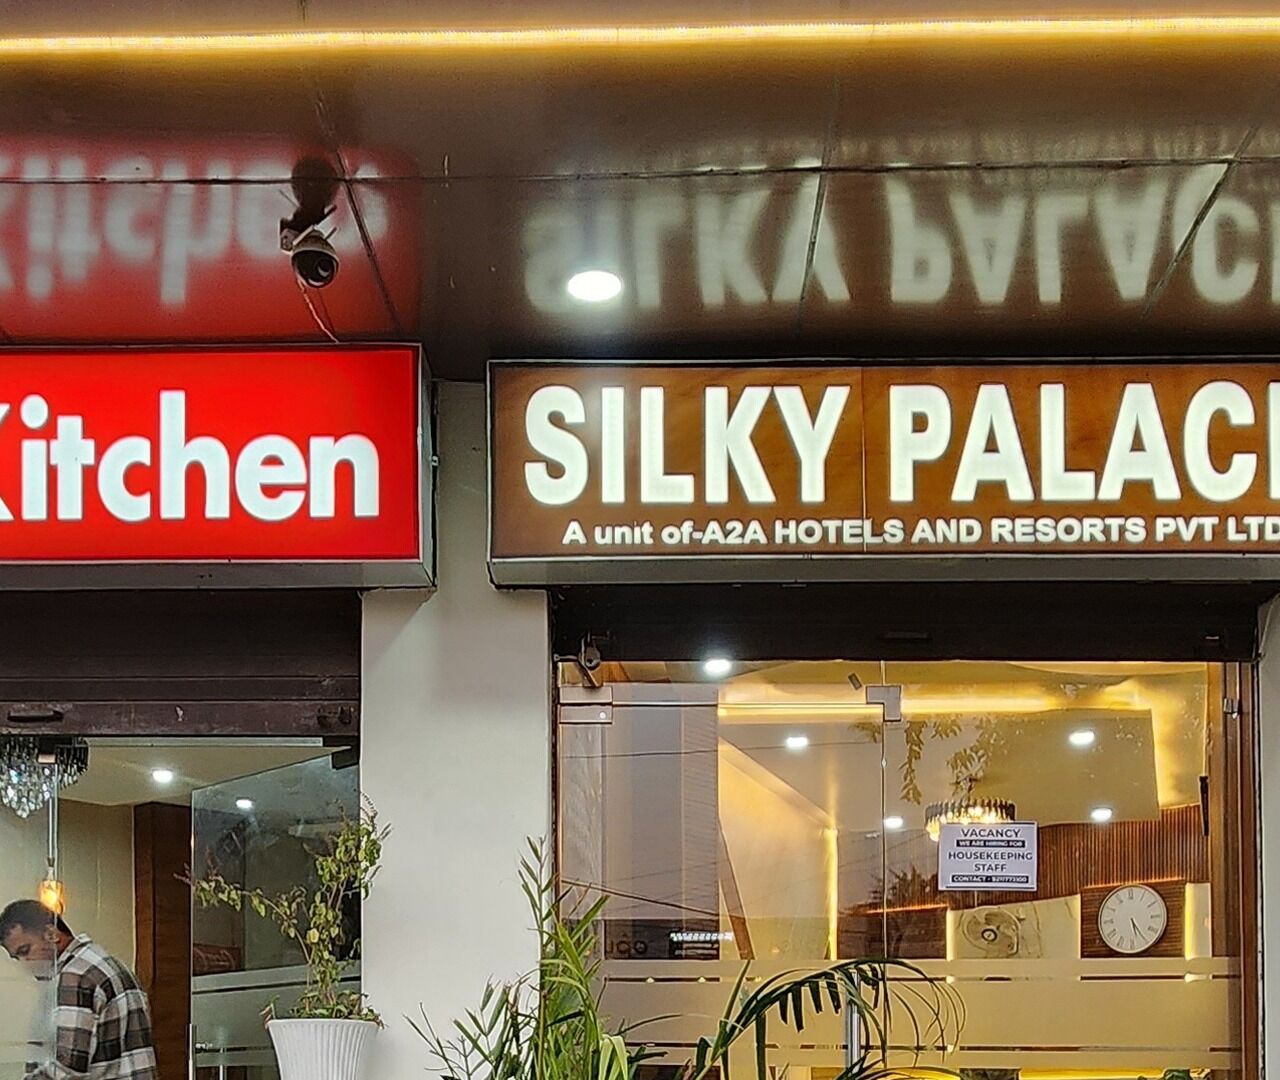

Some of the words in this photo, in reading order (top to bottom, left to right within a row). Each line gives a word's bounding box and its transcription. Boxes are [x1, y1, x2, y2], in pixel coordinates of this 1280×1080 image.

[523, 384, 851, 506] SILKY
[561, 520, 588, 546] A
[593, 520, 654, 547] unit
[660, 519, 768, 547] of-A2A
[774, 518, 905, 545] HOTELS
[910, 518, 983, 544] AND
[990, 516, 1147, 544] RESORTS
[1154, 516, 1220, 543] PVT
[960, 828, 1021, 838] VACANCY
[948, 851, 1033, 861] HOUSEKEEPING
[974, 863, 1007, 872] STAFF
